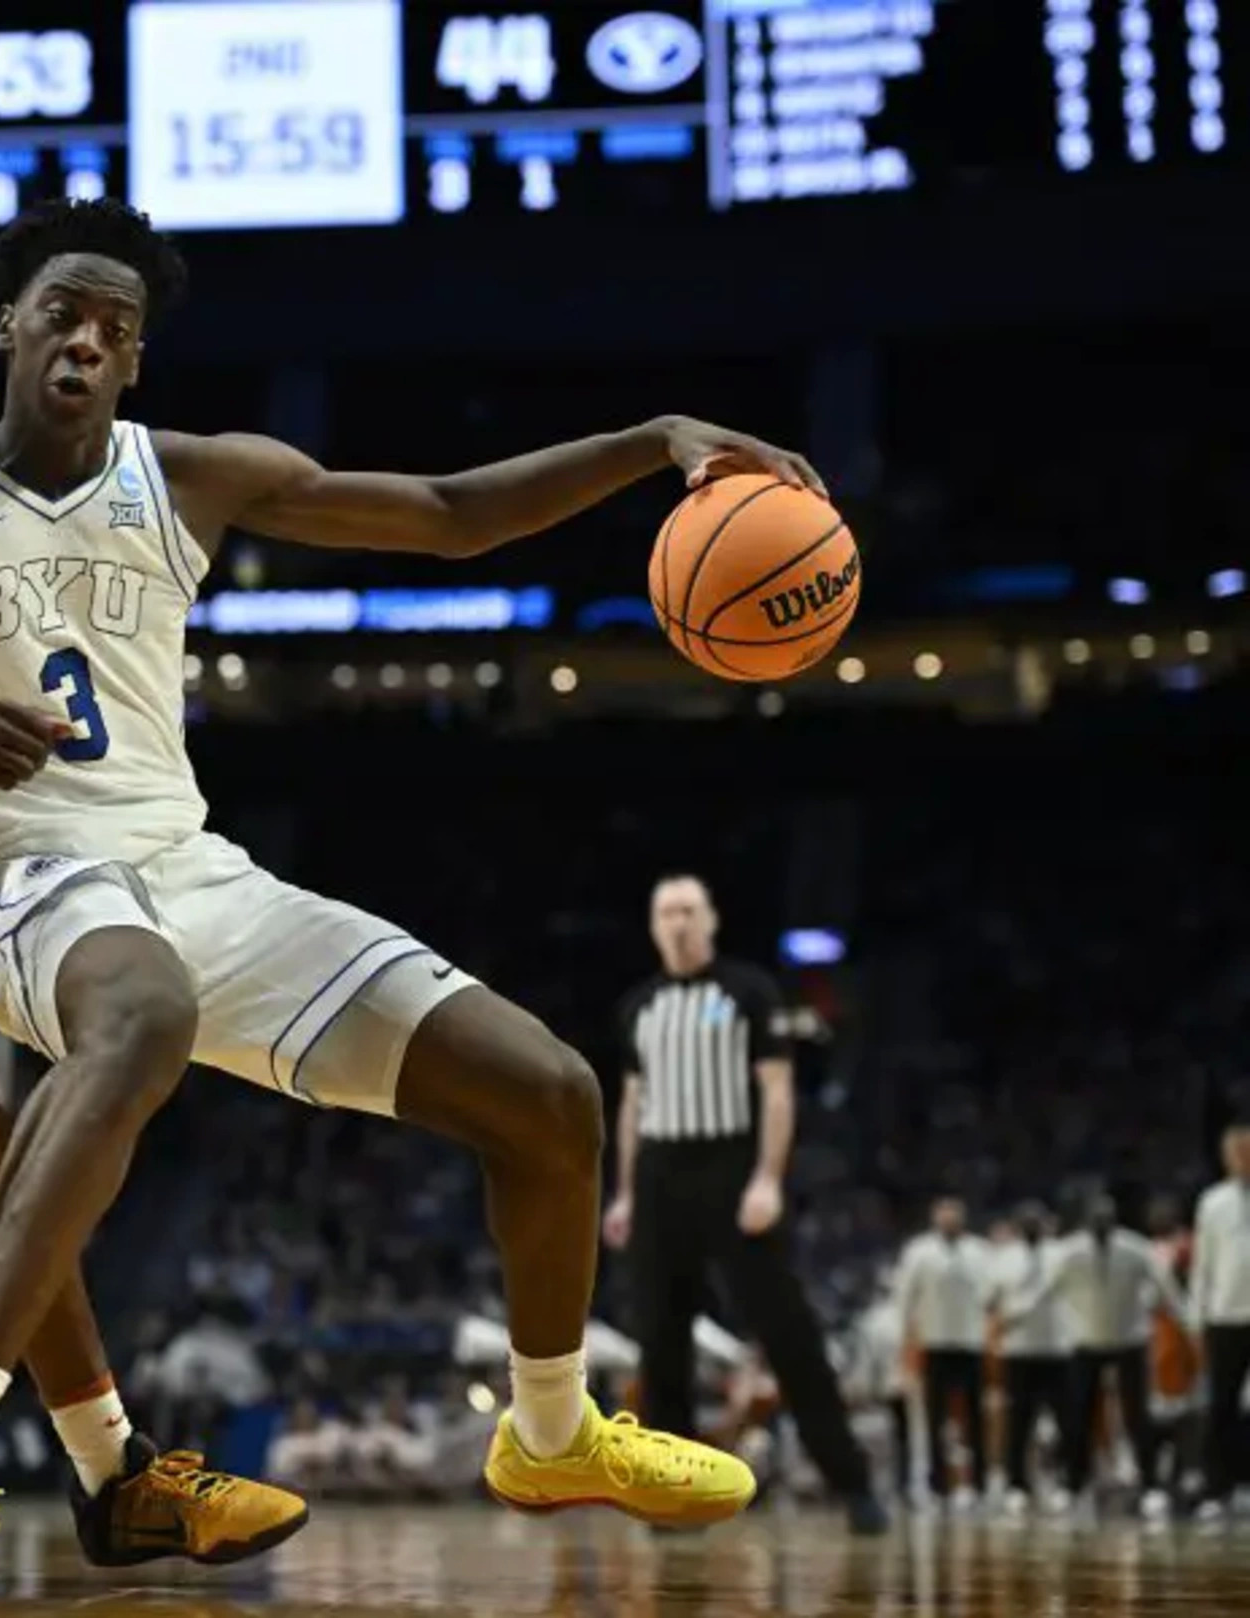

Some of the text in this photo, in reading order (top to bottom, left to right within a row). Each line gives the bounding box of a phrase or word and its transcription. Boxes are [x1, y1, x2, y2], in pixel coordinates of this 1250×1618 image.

[436, 14, 555, 104] 44
[168, 108, 368, 179] 15:59
[39, 646, 110, 762] 3
